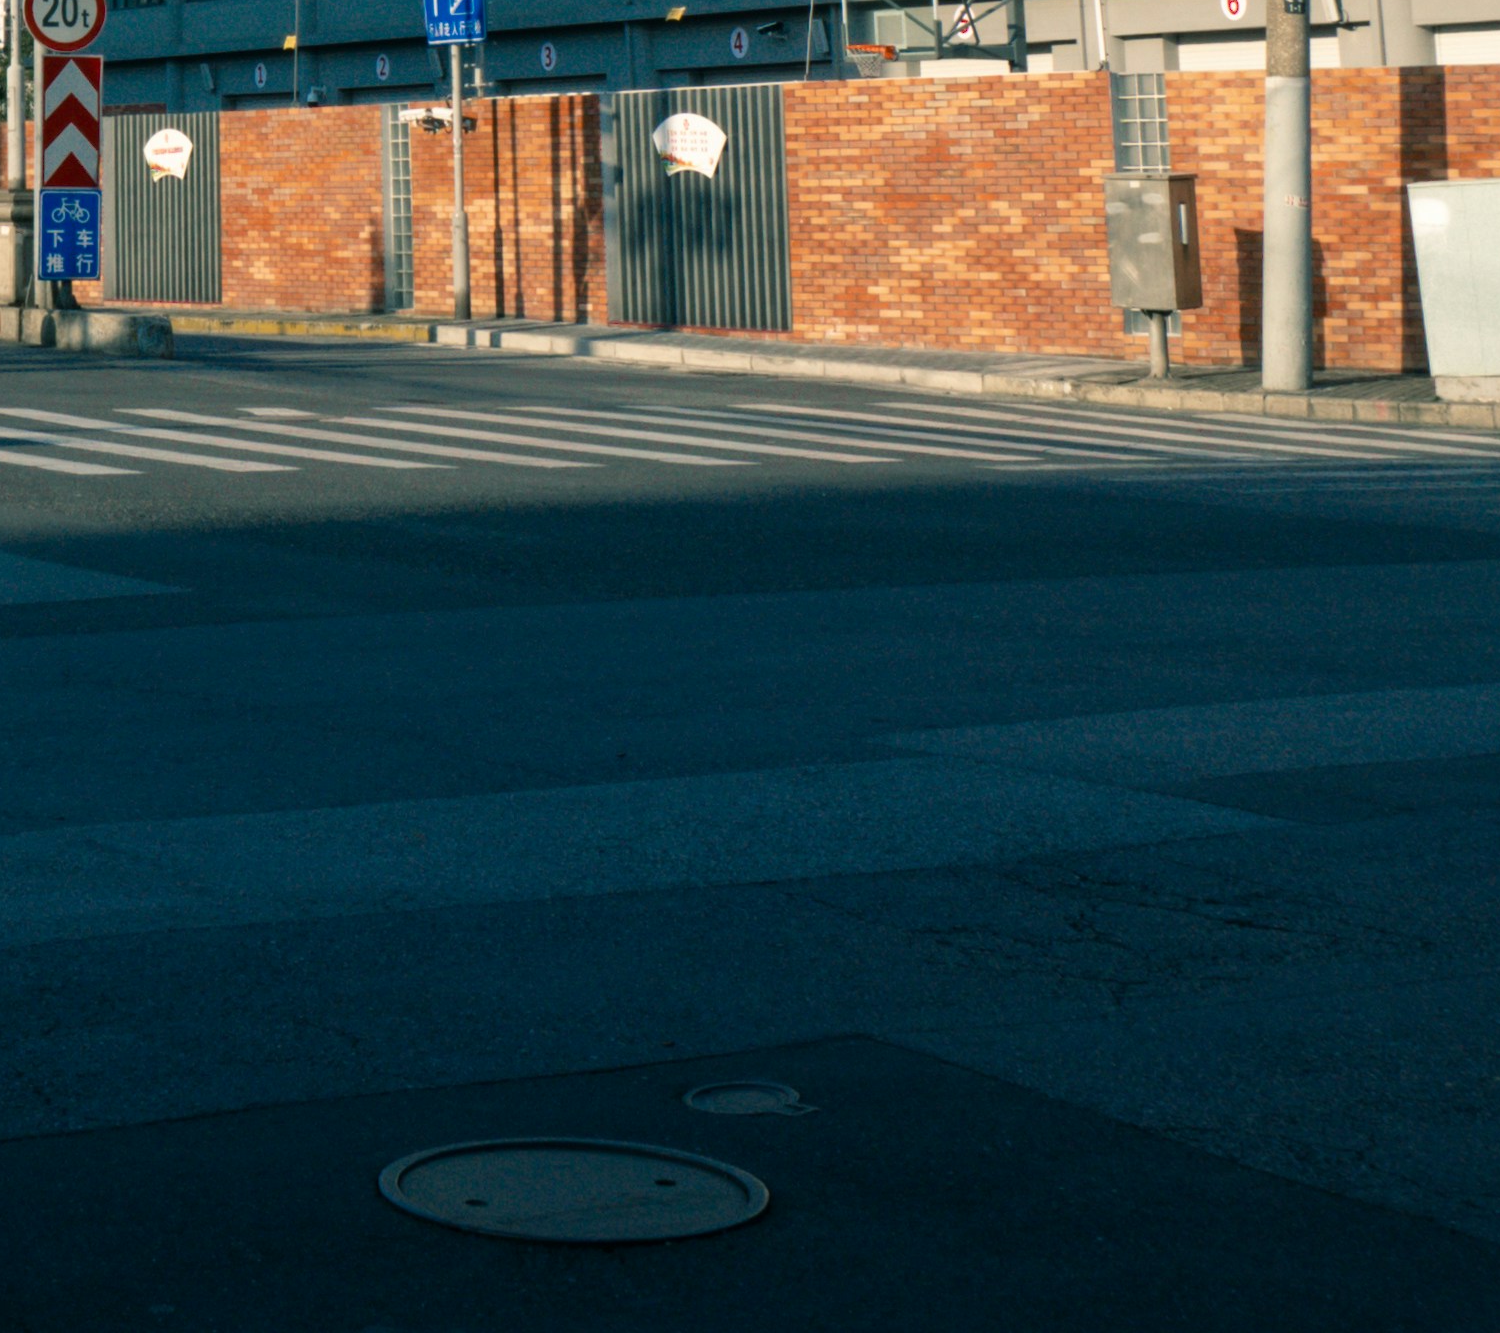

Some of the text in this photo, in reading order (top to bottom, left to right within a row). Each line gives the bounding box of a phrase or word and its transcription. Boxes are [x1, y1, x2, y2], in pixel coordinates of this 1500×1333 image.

[734, 32, 743, 54] 4
[544, 47, 552, 67] 3
[258, 66, 264, 84] 1
[380, 58, 387, 76] 2
[46, 229, 94, 248] 下车
[46, 253, 94, 273] 推行
